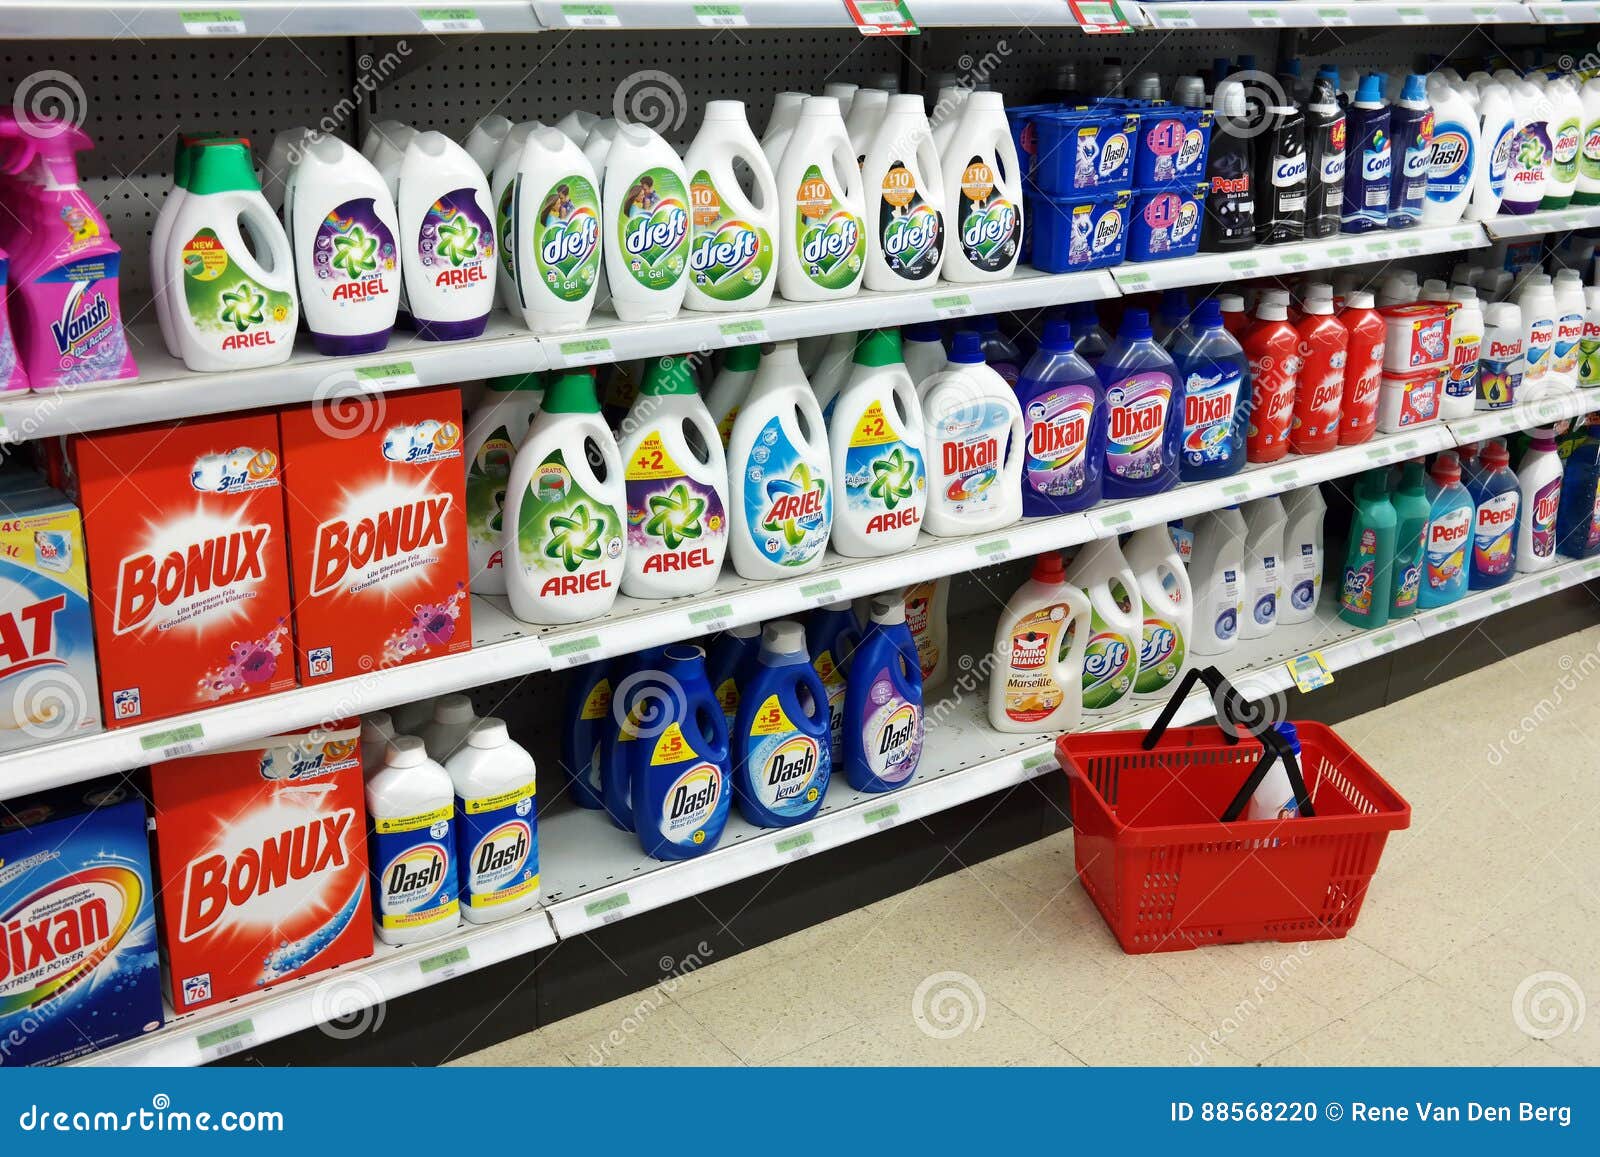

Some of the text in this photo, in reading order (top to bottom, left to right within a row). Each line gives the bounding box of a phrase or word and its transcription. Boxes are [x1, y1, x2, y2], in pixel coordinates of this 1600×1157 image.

[1104, 143, 1126, 162] Dash
[1180, 139, 1201, 157] Dash
[1440, 141, 1456, 150] Gel
[1555, 137, 1577, 149] ARIEL
[1367, 156, 1390, 171] Cora
[1212, 173, 1249, 193] Persil
[1513, 171, 1545, 181] ARIEL
[965, 208, 1015, 249] dreft
[1098, 220, 1119, 238] Dash
[1176, 211, 1196, 229] Dash
[543, 217, 598, 265] dreft
[626, 208, 687, 254] dreft
[887, 214, 937, 255] dreft
[193, 241, 214, 249] NEW
[690, 230, 758, 270] dreft
[804, 221, 857, 262] dreft
[435, 267, 487, 286] ARIEL
[648, 270, 664, 279] Gel
[333, 279, 389, 300] ARIEL
[563, 281, 578, 289] Gel
[50, 288, 111, 355] Vanish
[222, 331, 276, 350] ARIEL
[1423, 333, 1442, 344] BONUX
[1531, 331, 1552, 343] Pers
[1454, 344, 1480, 366] Dixa
[1490, 339, 1522, 357] Persil
[1413, 392, 1432, 402] BONUX
[1185, 393, 1232, 426] Dixan
[863, 418, 885, 436] +2
[1112, 404, 1162, 439] Dixan
[1033, 418, 1085, 455] Dixan
[406, 442, 433, 461] 3in1
[638, 450, 664, 470] +2
[943, 438, 998, 476] Dixan
[217, 471, 248, 491] 3in1
[765, 490, 822, 523] ARIEL
[1479, 503, 1516, 526] Persil
[1539, 496, 1560, 520] Dixa
[866, 507, 920, 534] ARIEL
[1432, 519, 1469, 542] Persil
[314, 497, 450, 592] BONUX
[643, 548, 715, 574] ARIEL
[116, 526, 269, 633] BONUX
[350, 576, 380, 592] Explosion
[540, 569, 612, 597] ARIEL
[223, 588, 236, 599] Fris
[158, 613, 192, 630] Explosion
[907, 612, 926, 625] MINO
[1012, 657, 1045, 665] BIANCO
[1013, 649, 1047, 658] OMINO
[315, 661, 328, 672] 50
[1008, 678, 1052, 688] Marseille
[121, 703, 135, 714] 50
[760, 709, 781, 723] +5
[661, 737, 682, 752] +5
[880, 714, 914, 755] Dash
[289, 754, 324, 779] 3in1
[768, 747, 814, 786] Dash
[670, 774, 717, 820] Dash
[476, 832, 526, 875] Dash
[183, 813, 351, 938] BONUX
[387, 854, 442, 895] Dash
[28, 893, 95, 923] Champion des taches
[0, 951, 85, 994] EXTREME POWER
[190, 987, 205, 999] 76
